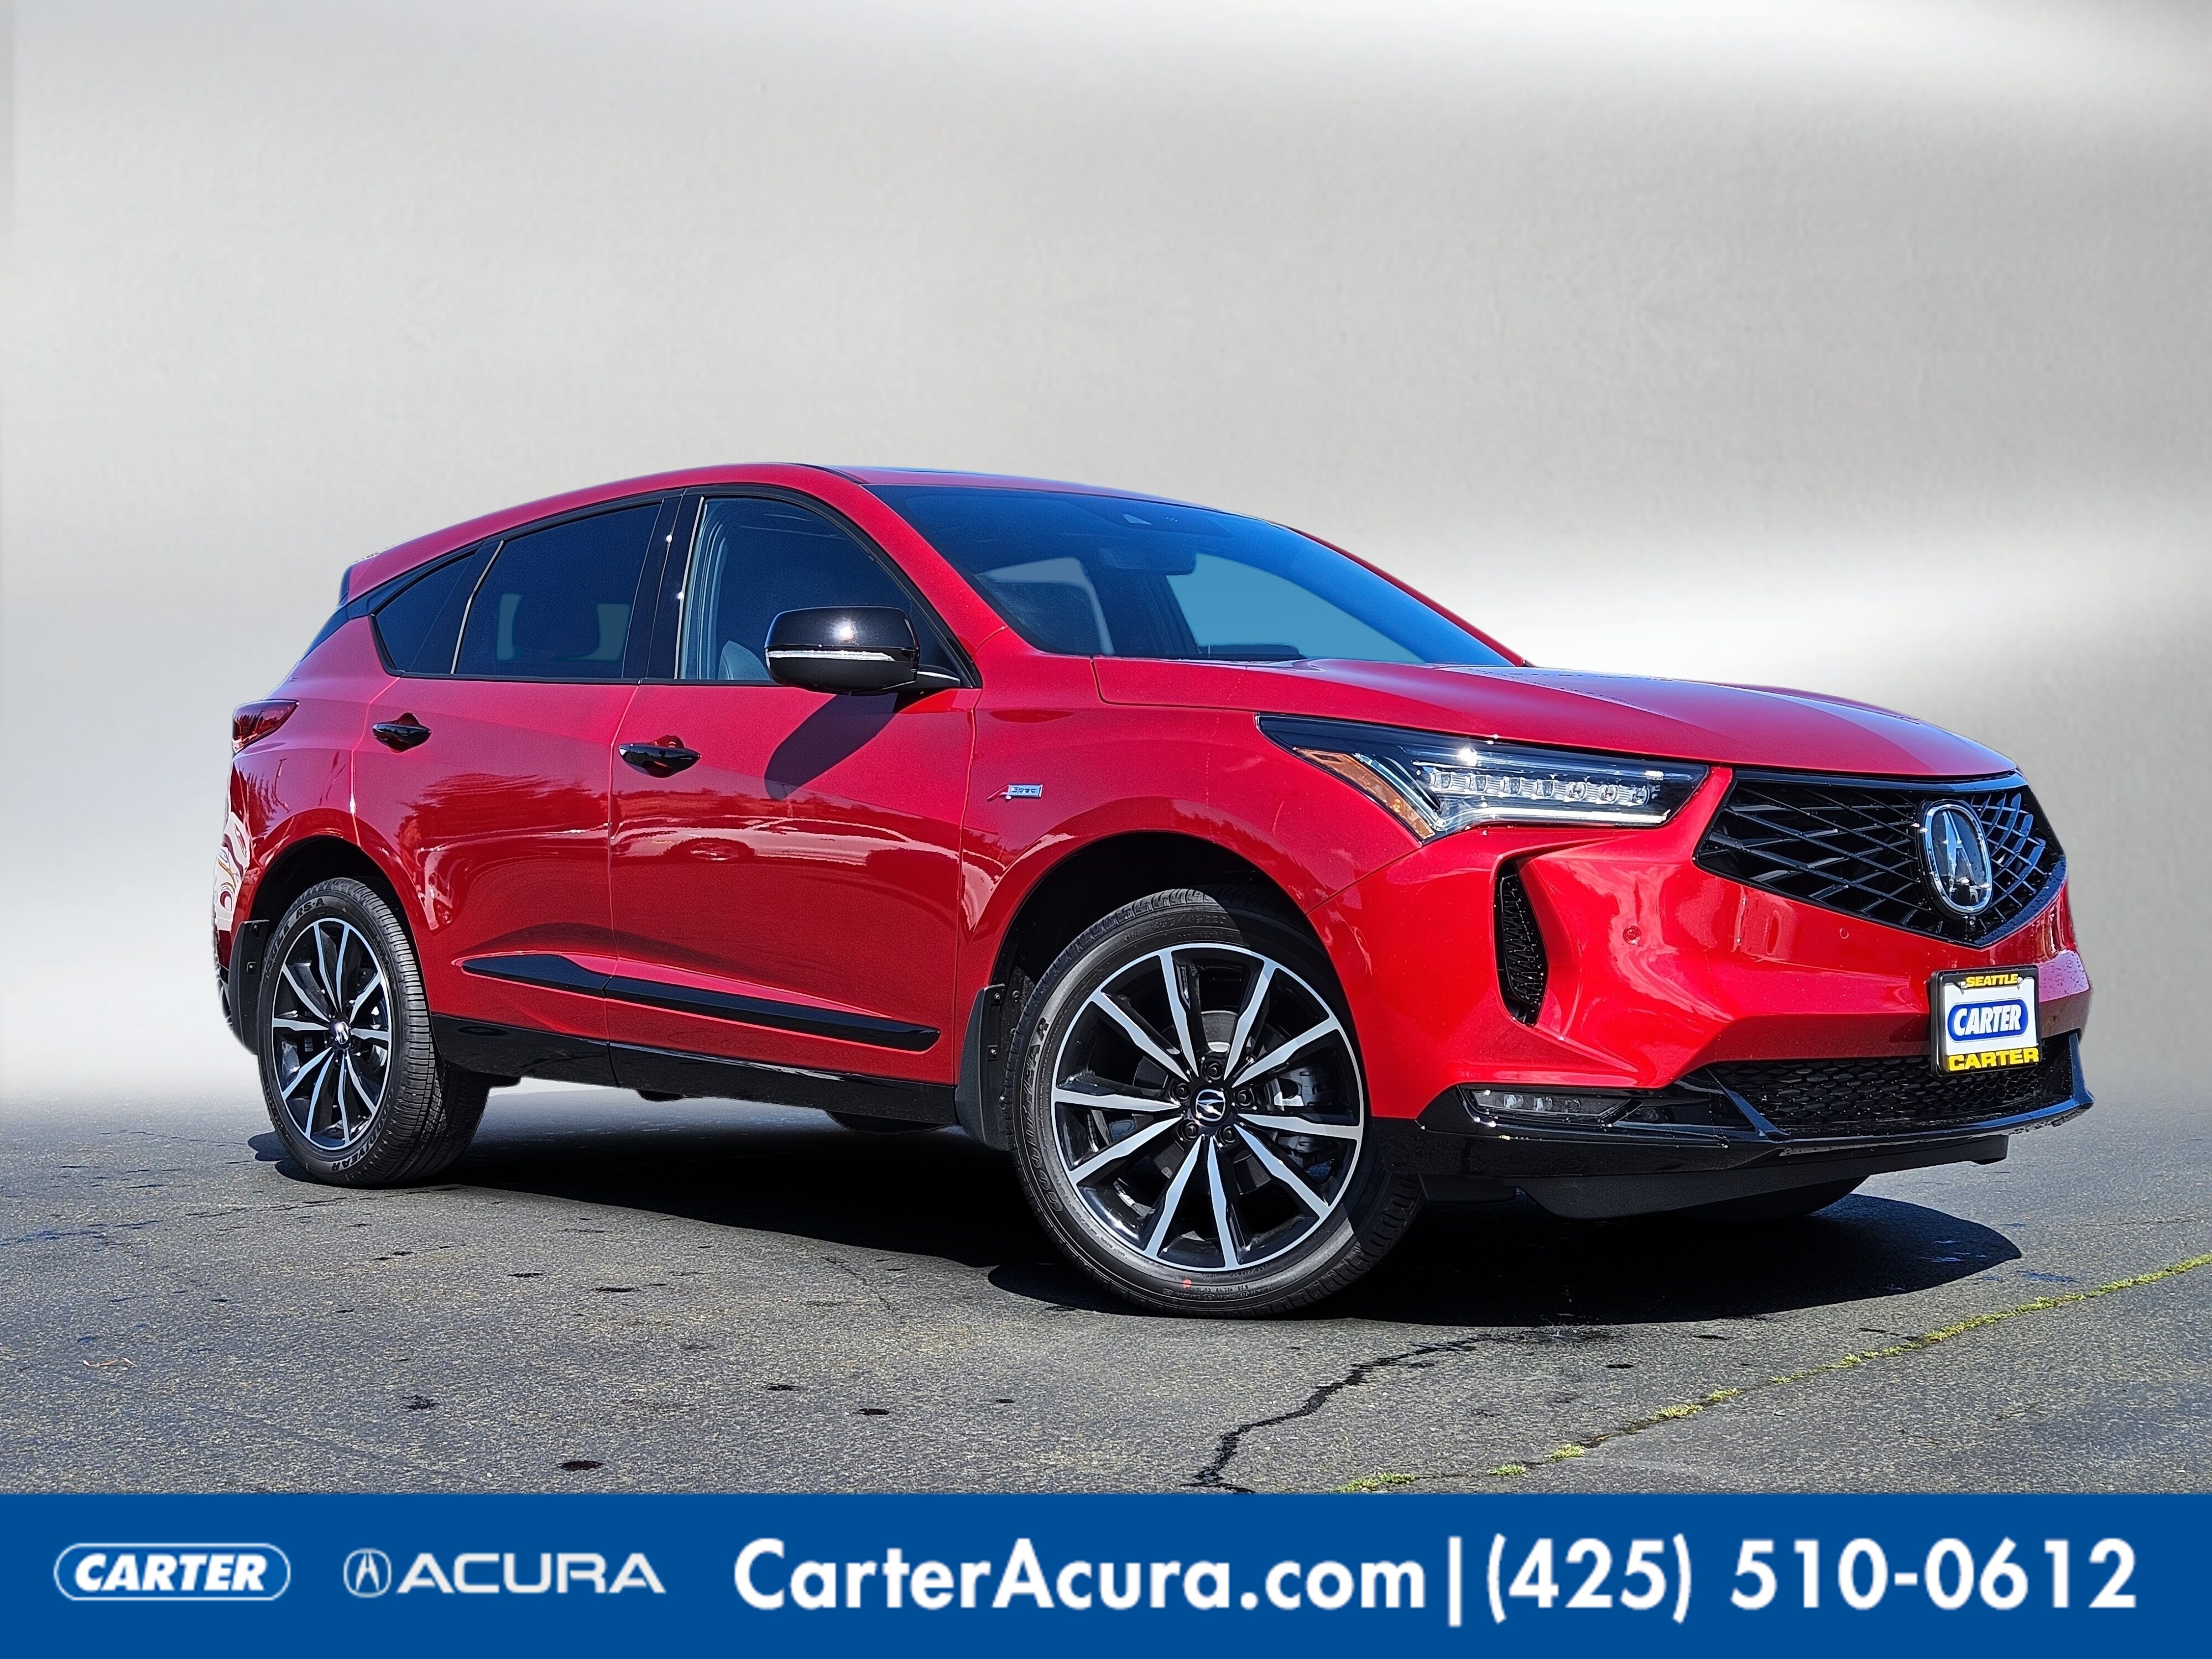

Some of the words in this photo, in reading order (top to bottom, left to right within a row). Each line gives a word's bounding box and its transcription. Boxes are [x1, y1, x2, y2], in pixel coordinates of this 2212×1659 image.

[1966, 973, 2018, 988] SEATTLE
[1953, 1004, 2022, 1036] CARTER
[1948, 1047, 2039, 1072] CARTER
[1023, 1016, 1063, 1212] GOODYEAR
